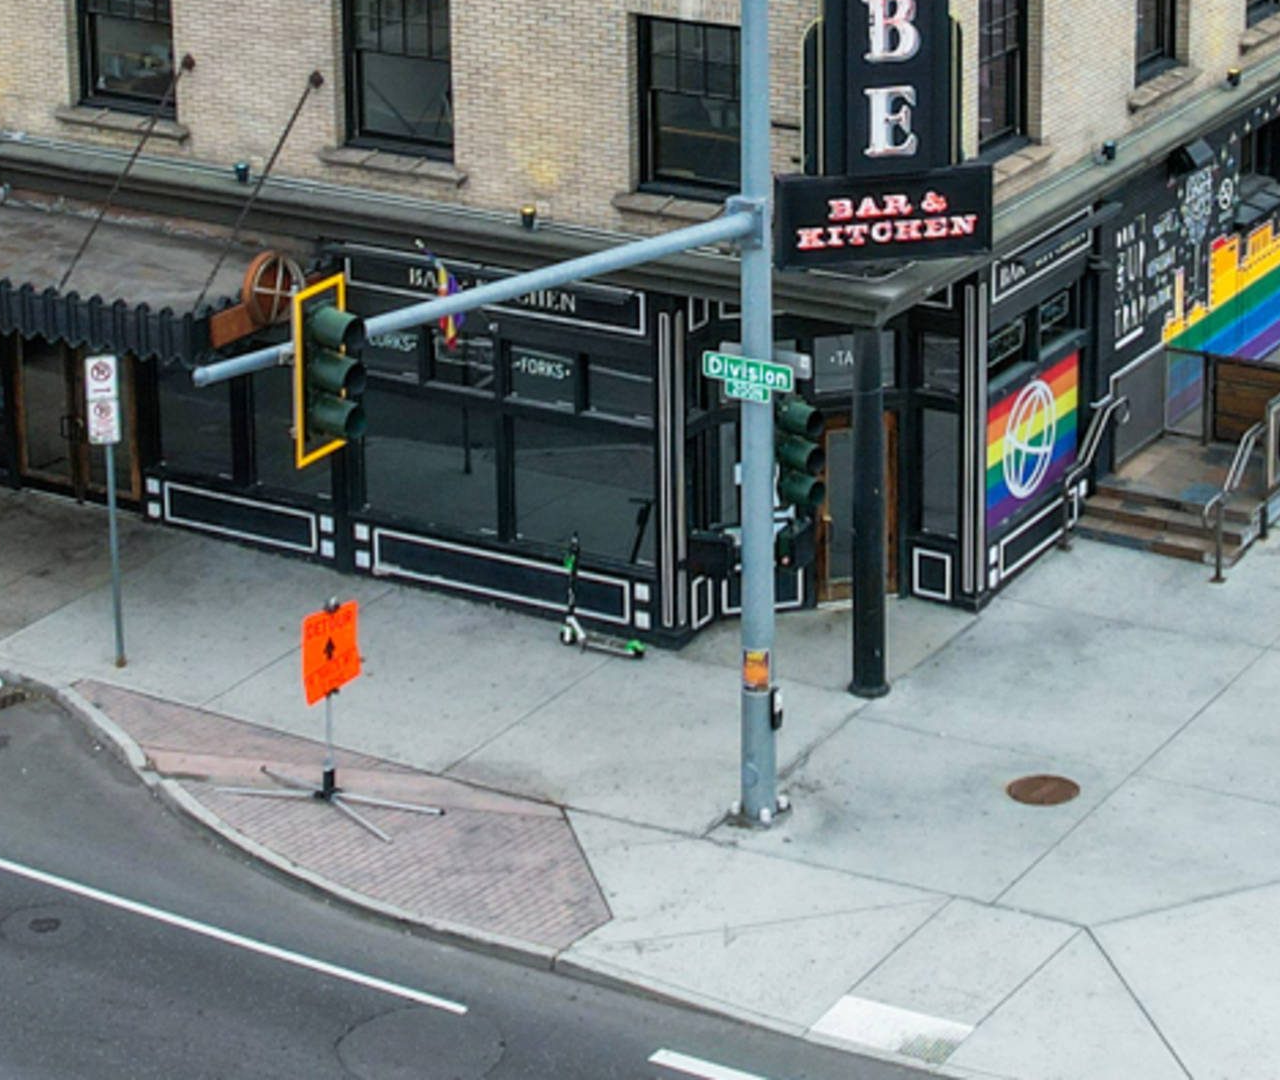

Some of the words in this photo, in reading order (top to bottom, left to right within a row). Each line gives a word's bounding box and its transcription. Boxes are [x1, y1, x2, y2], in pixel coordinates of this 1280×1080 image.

[827, 194, 913, 220] BAR
[920, 190, 948, 214] &
[795, 214, 978, 250] KITCHEN
[521, 357, 565, 380] FORKS
[708, 356, 789, 388] Division
